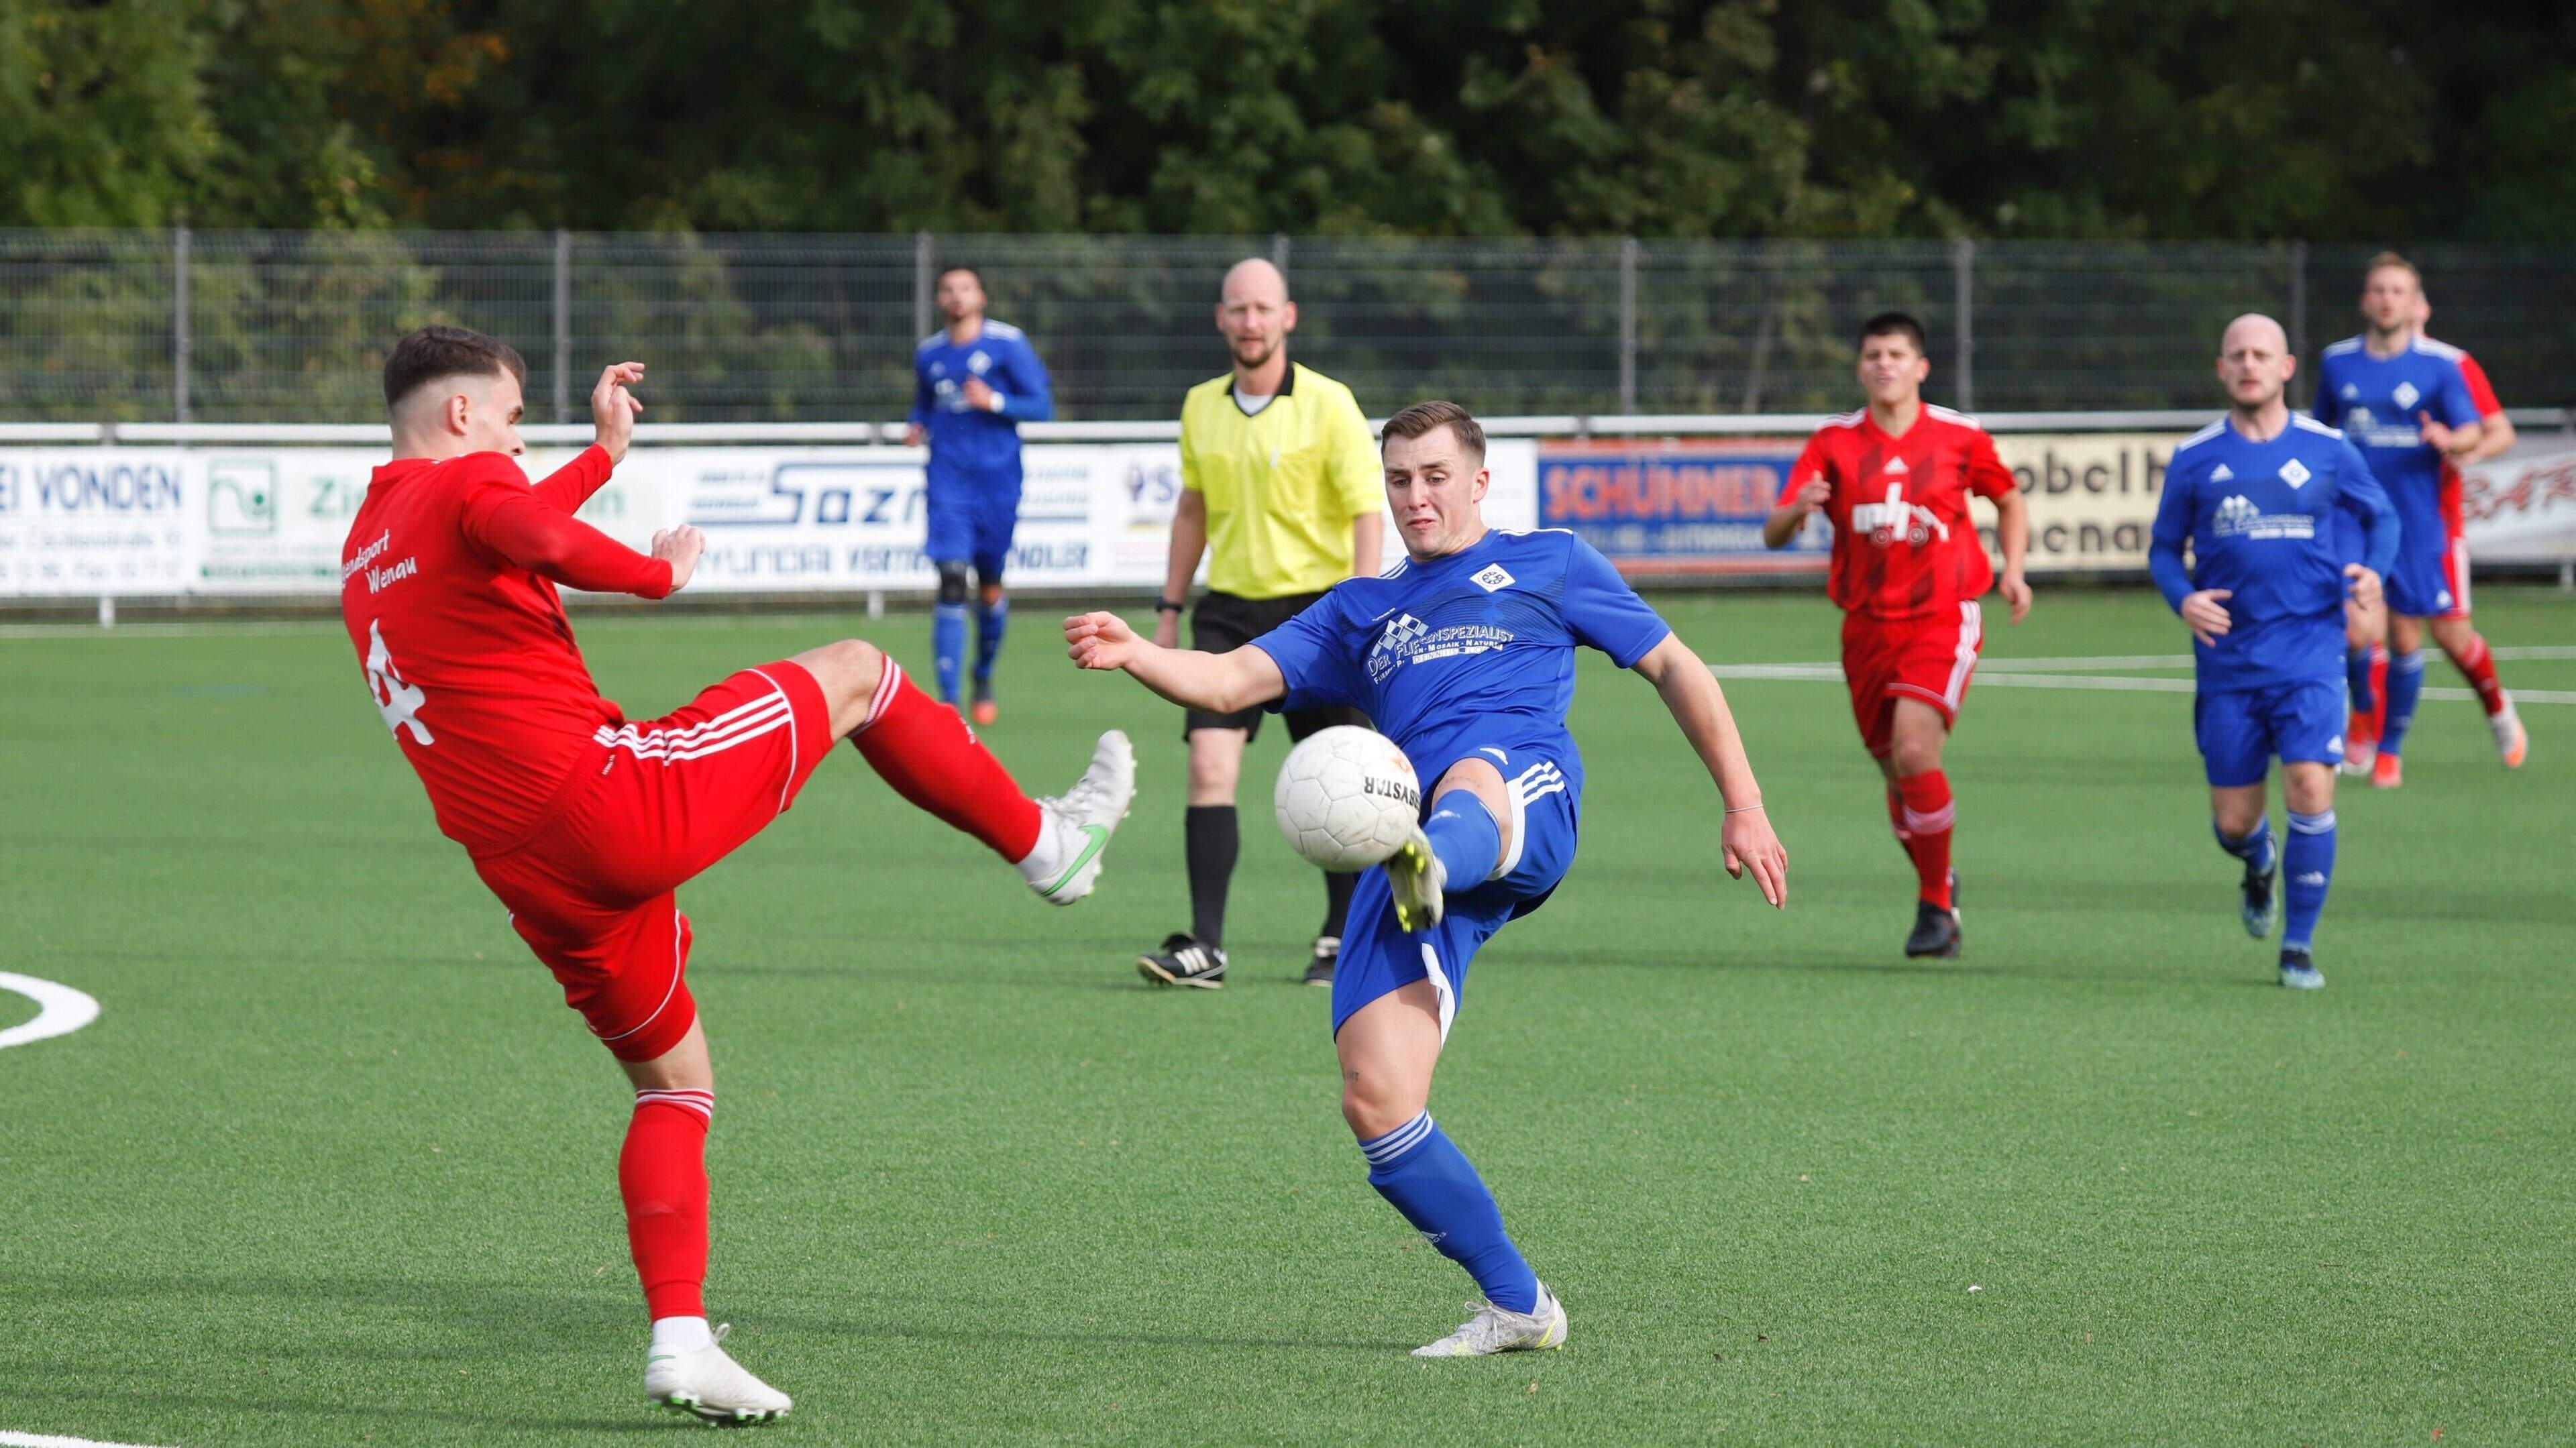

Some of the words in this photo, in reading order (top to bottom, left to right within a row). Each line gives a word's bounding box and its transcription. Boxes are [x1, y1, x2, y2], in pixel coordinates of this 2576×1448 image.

[36, 464, 182, 511] VONDEN
[1545, 457, 1779, 520] SCHÜMMER
[366, 555, 417, 594] Wenau
[1368, 654, 1391, 677] DER
[1428, 641, 1460, 654] MOSAIK
[366, 618, 435, 746] 4
